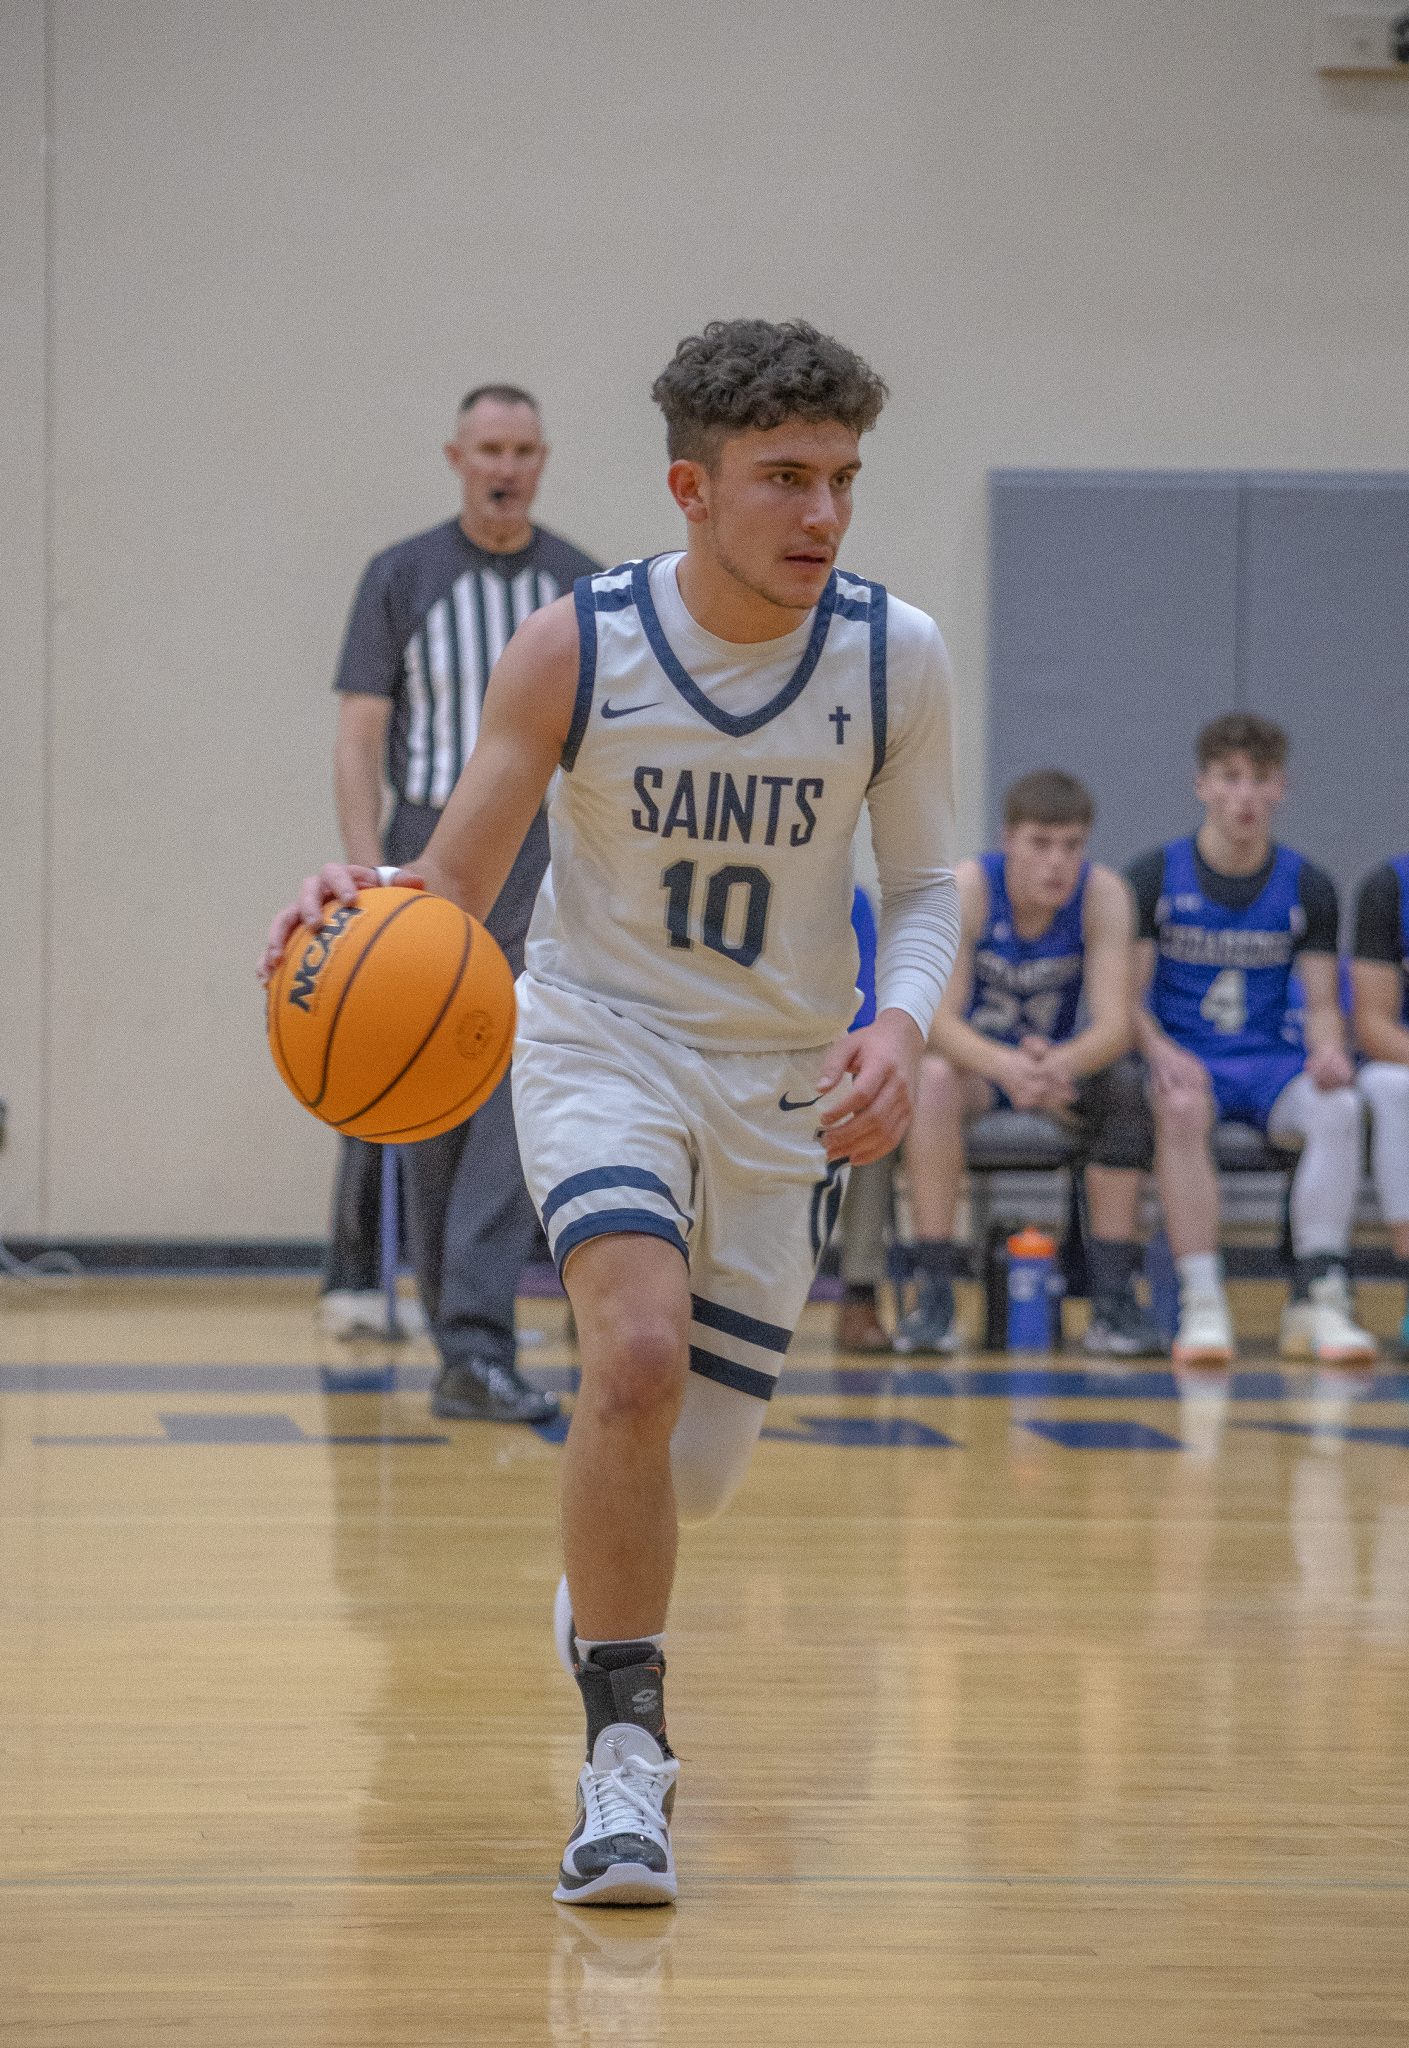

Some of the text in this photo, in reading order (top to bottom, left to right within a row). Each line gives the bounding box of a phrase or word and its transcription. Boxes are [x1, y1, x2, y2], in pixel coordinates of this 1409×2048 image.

[631, 765, 824, 847] SAINTS
[289, 905, 366, 1013] NCAA
[659, 857, 773, 968] 10
[1202, 969, 1247, 1035] 4
